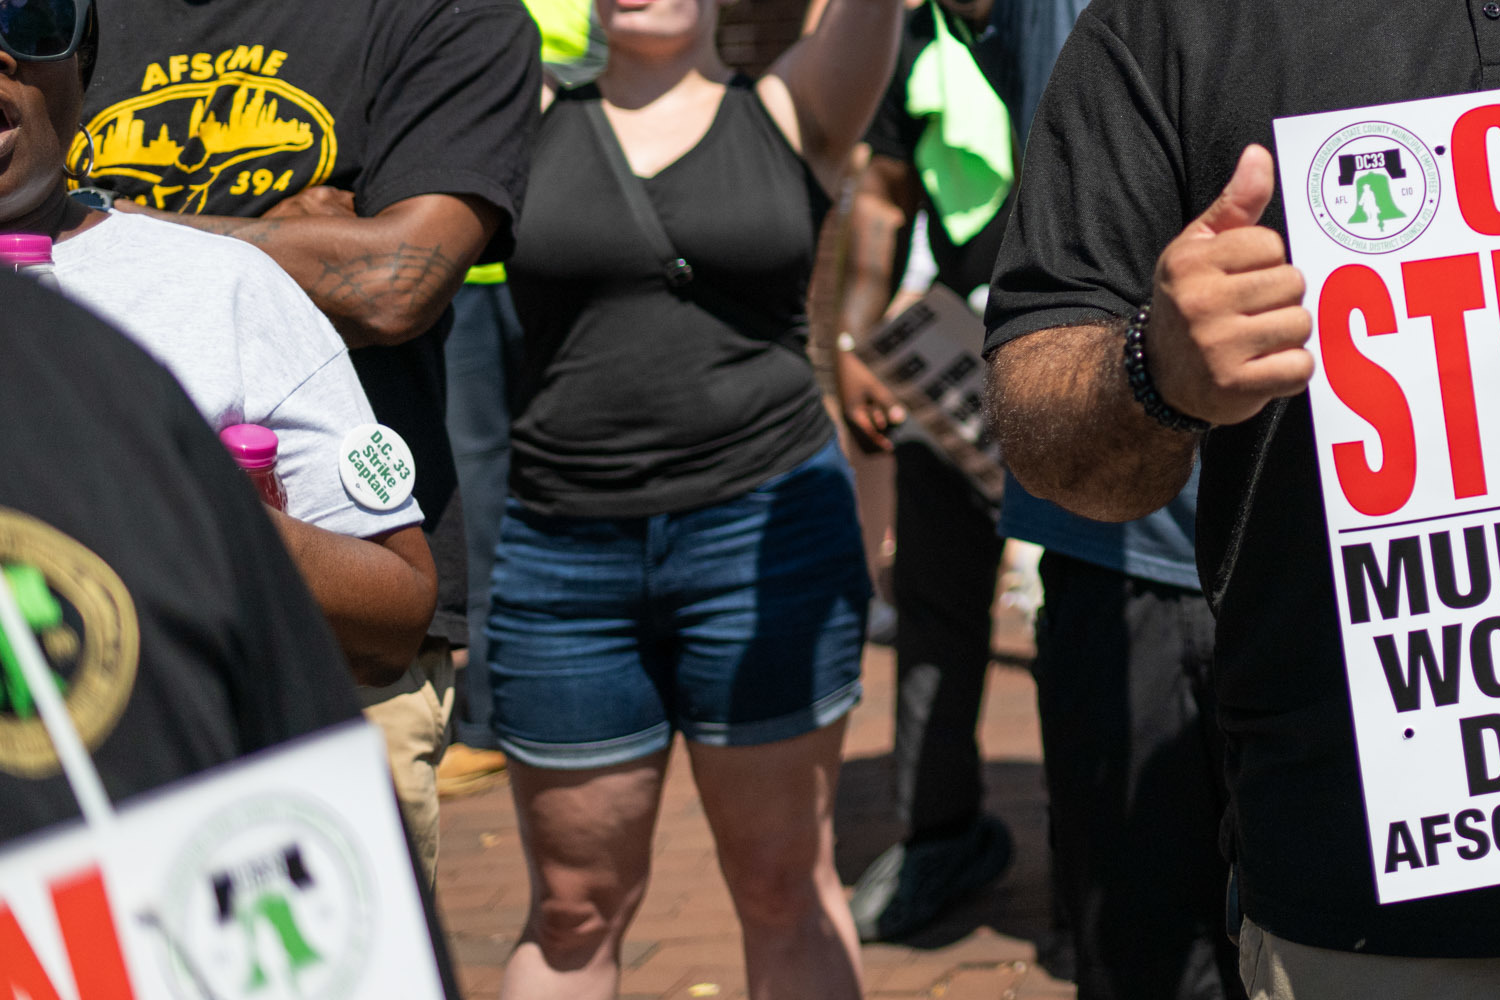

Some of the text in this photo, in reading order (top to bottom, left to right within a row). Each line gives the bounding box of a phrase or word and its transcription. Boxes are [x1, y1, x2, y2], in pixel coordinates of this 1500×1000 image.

[1355, 152, 1385, 171] DC33
[230, 168, 294, 196] 394
[1335, 187, 1414, 205] AFL CIO
[362, 445, 397, 488] Strike
[370, 430, 411, 480] D.C. 33
[347, 450, 390, 504] Captain
